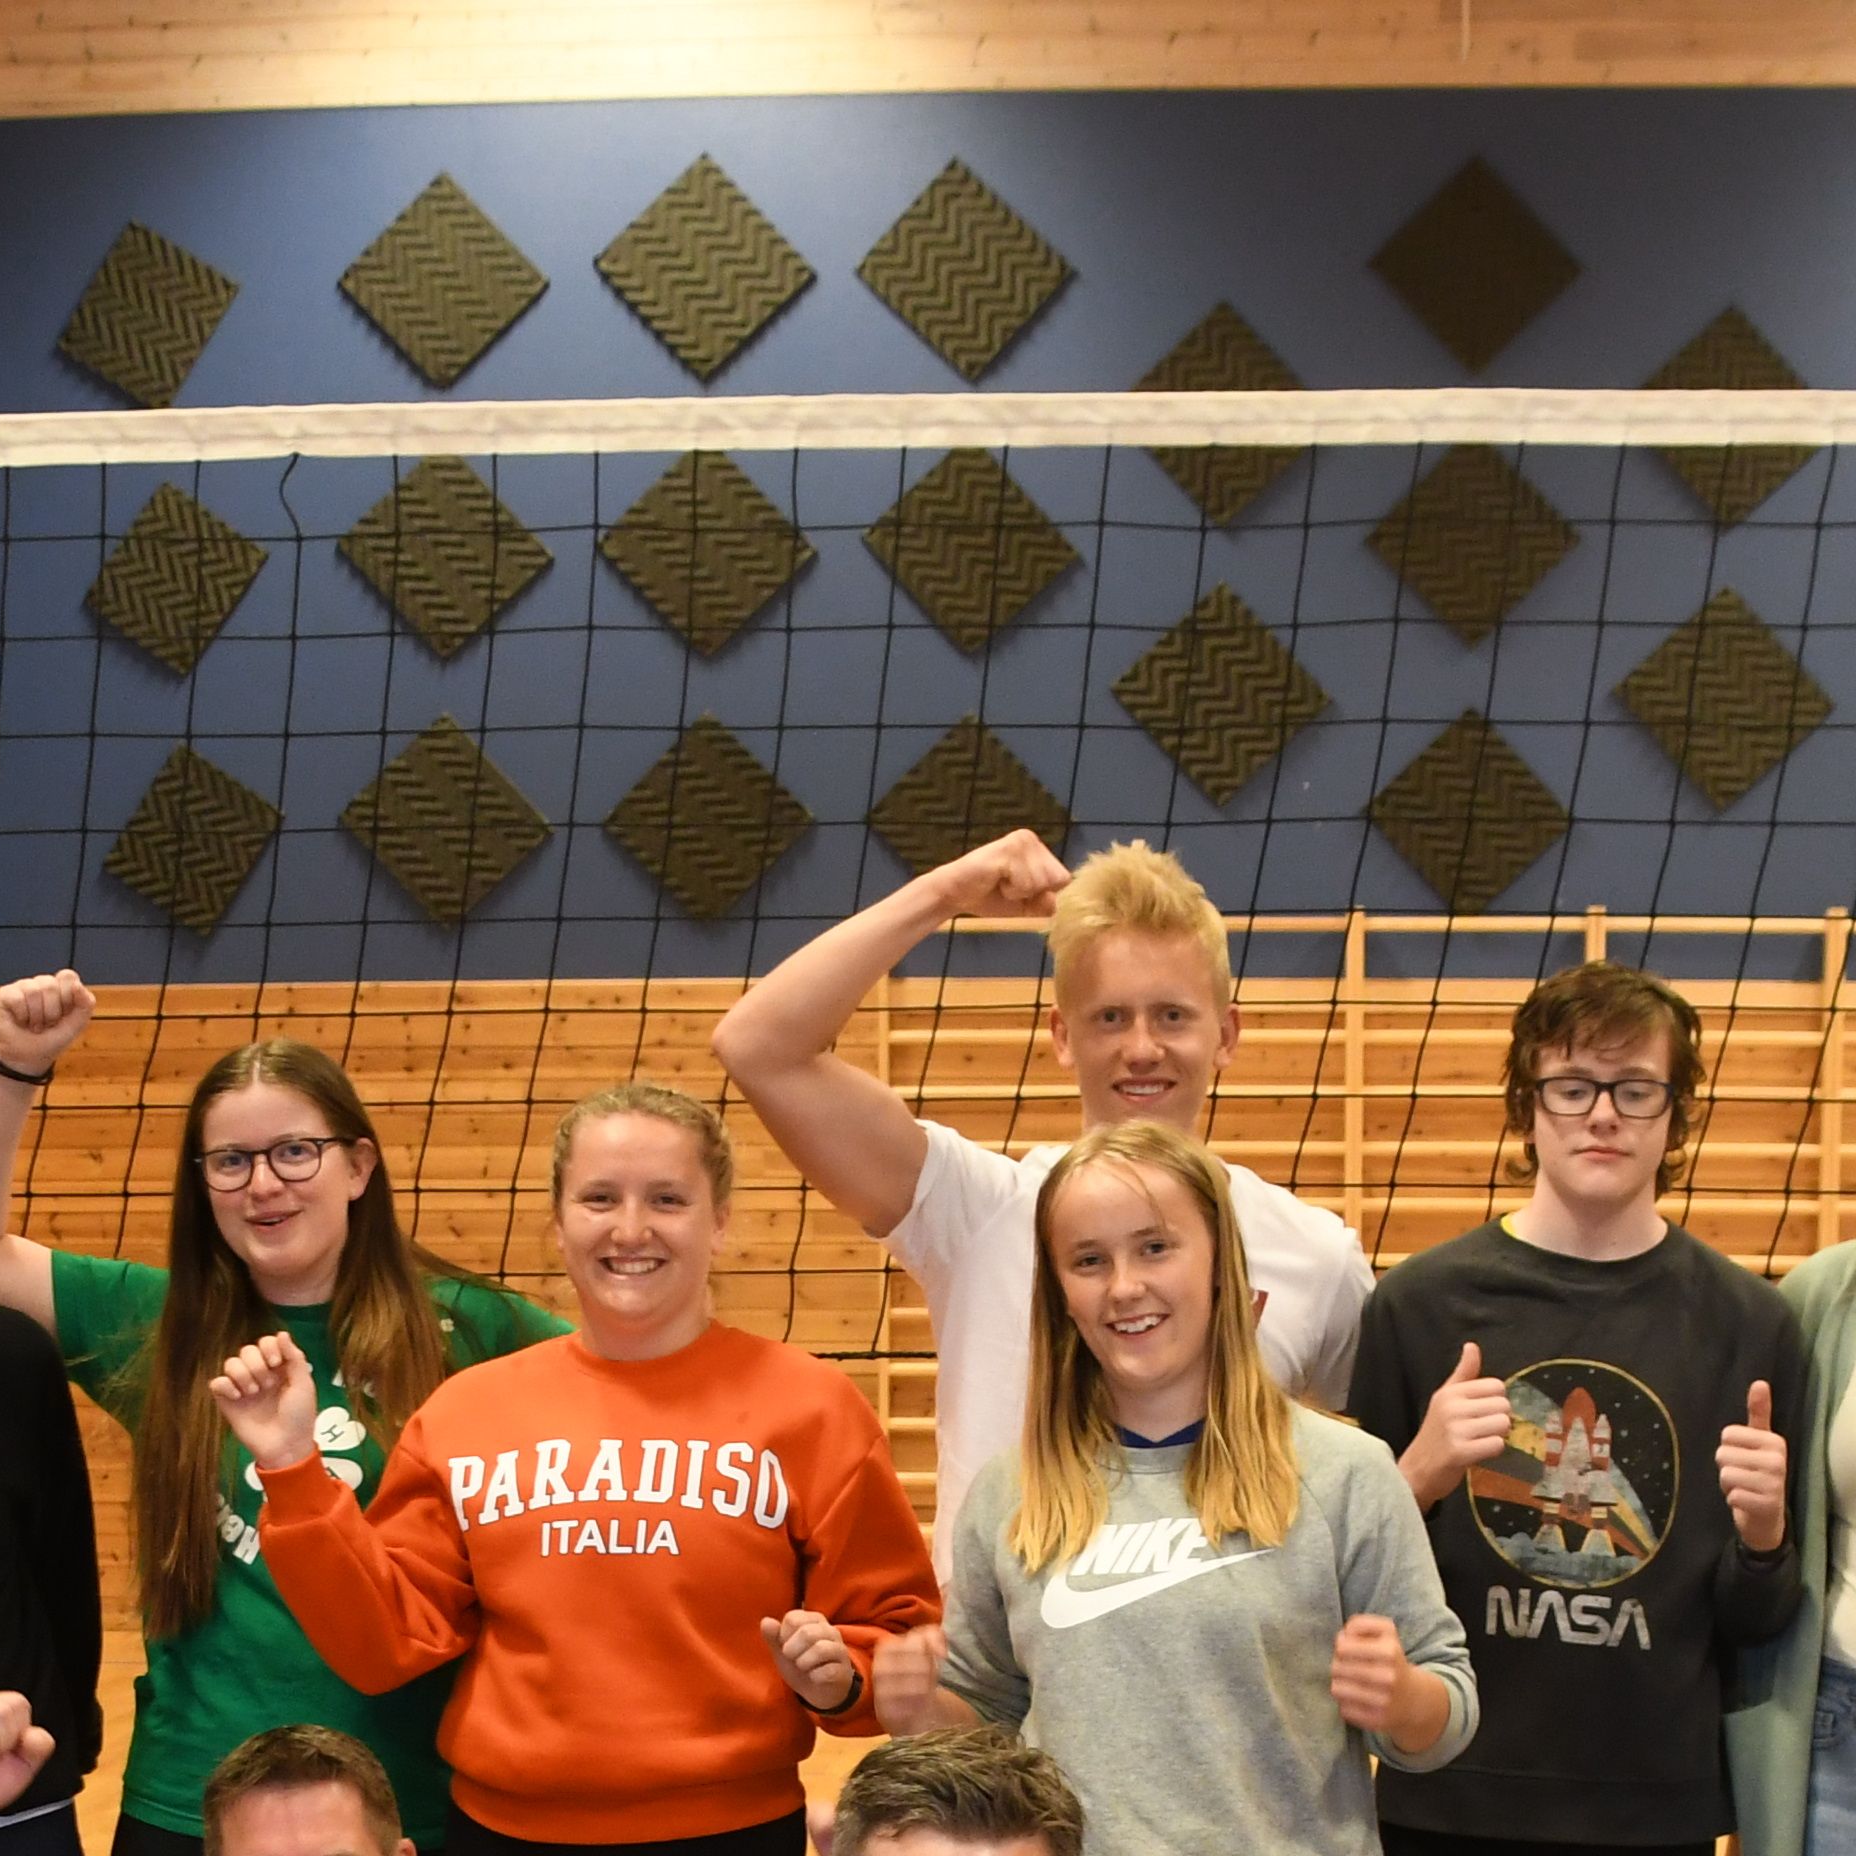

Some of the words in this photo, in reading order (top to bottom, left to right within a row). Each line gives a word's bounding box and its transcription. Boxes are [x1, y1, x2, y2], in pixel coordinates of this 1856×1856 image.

[448, 1437, 790, 1532] PARADISO
[541, 1518, 680, 1556] ITALIA
[1070, 1517, 1209, 1577] NIKE
[1485, 1585, 1652, 1650] NASA
